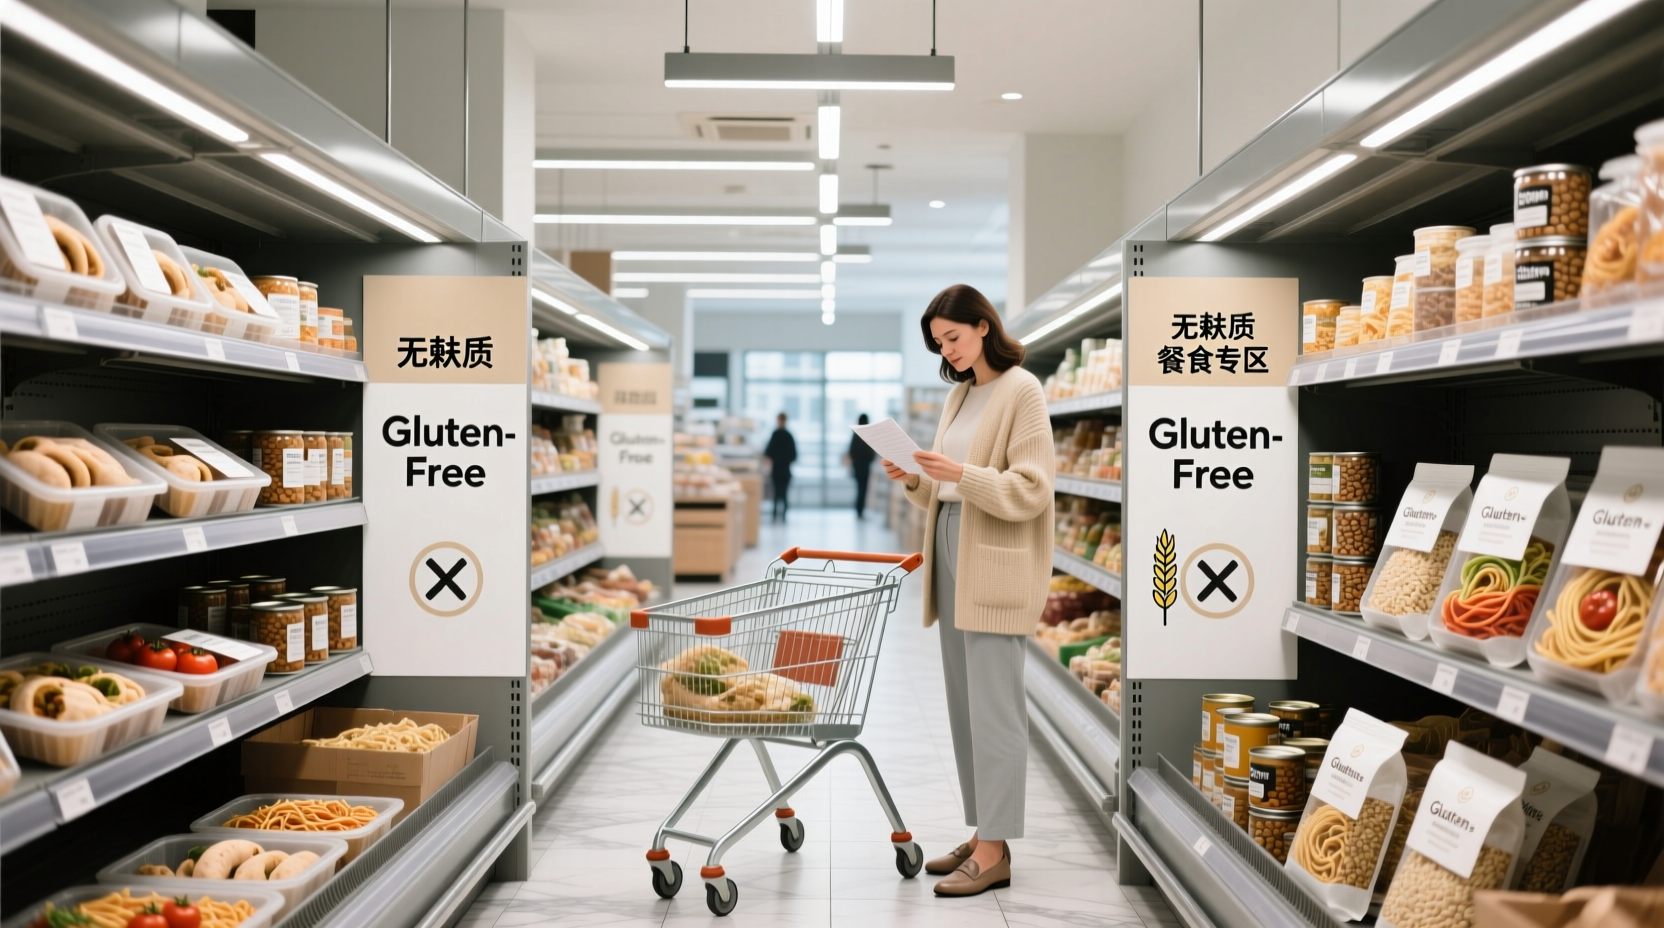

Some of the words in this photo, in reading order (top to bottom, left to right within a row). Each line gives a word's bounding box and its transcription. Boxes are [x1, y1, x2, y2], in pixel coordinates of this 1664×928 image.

[1157, 344, 1269, 374] 餐食专区
[382, 414, 516, 448] Gluten-
[1149, 417, 1283, 450] Gluten-
[406, 456, 486, 488] Free
[1173, 458, 1254, 490] Free
